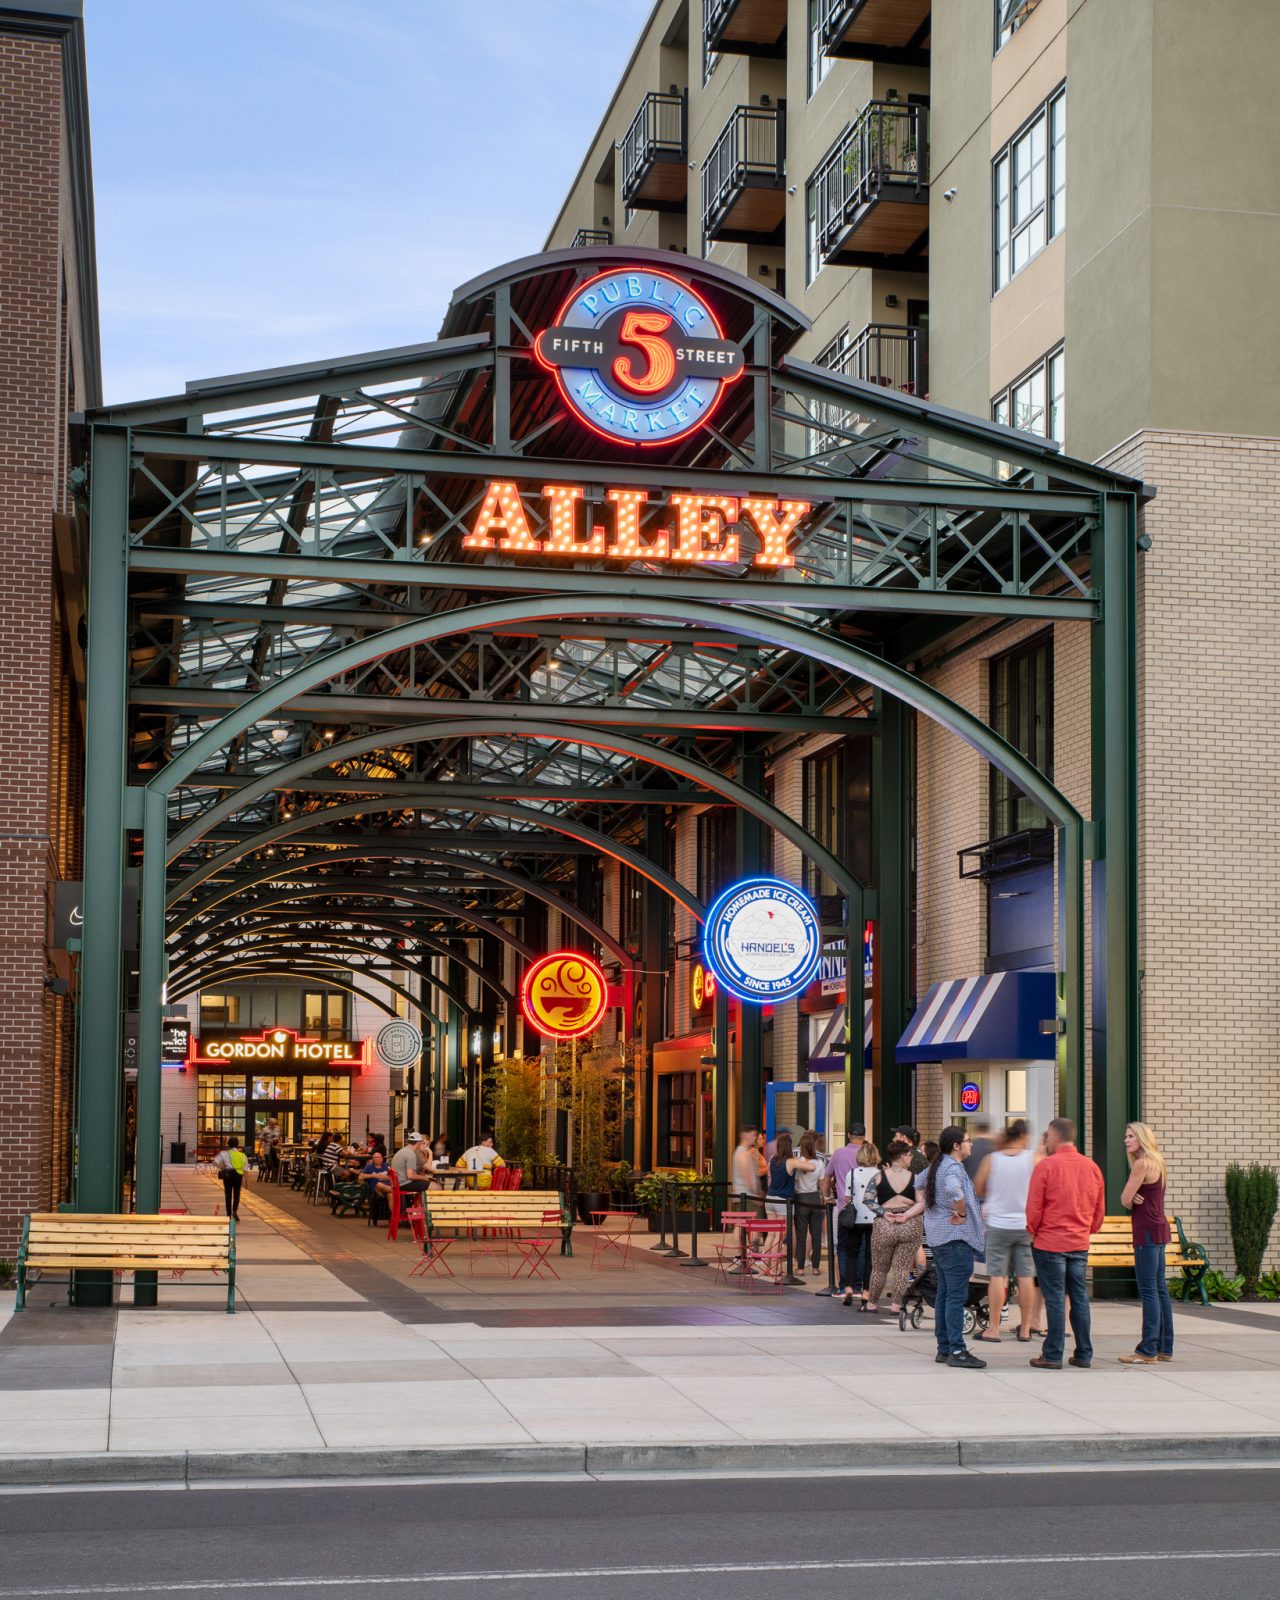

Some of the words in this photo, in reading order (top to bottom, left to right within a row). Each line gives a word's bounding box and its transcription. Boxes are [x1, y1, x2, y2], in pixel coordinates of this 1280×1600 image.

[579, 275, 706, 329] PUBLIC
[552, 338, 604, 354] FIFTH
[612, 312, 676, 394] 5
[675, 347, 736, 365] STREET
[575, 378, 707, 434] MARKET
[463, 481, 812, 567] ALLEY
[723, 889, 770, 922] HOMEMADE
[773, 890, 788, 901] ICE
[787, 896, 813, 926] CREAM
[741, 942, 795, 954] HANDEL'S
[743, 976, 770, 991] SINCE
[772, 978, 791, 990] 1945
[206, 1042, 285, 1058] GORDON
[295, 1044, 353, 1059] HOTEL
[961, 1090, 978, 1104] OPEN
[472, 1157, 477, 1170] 1
